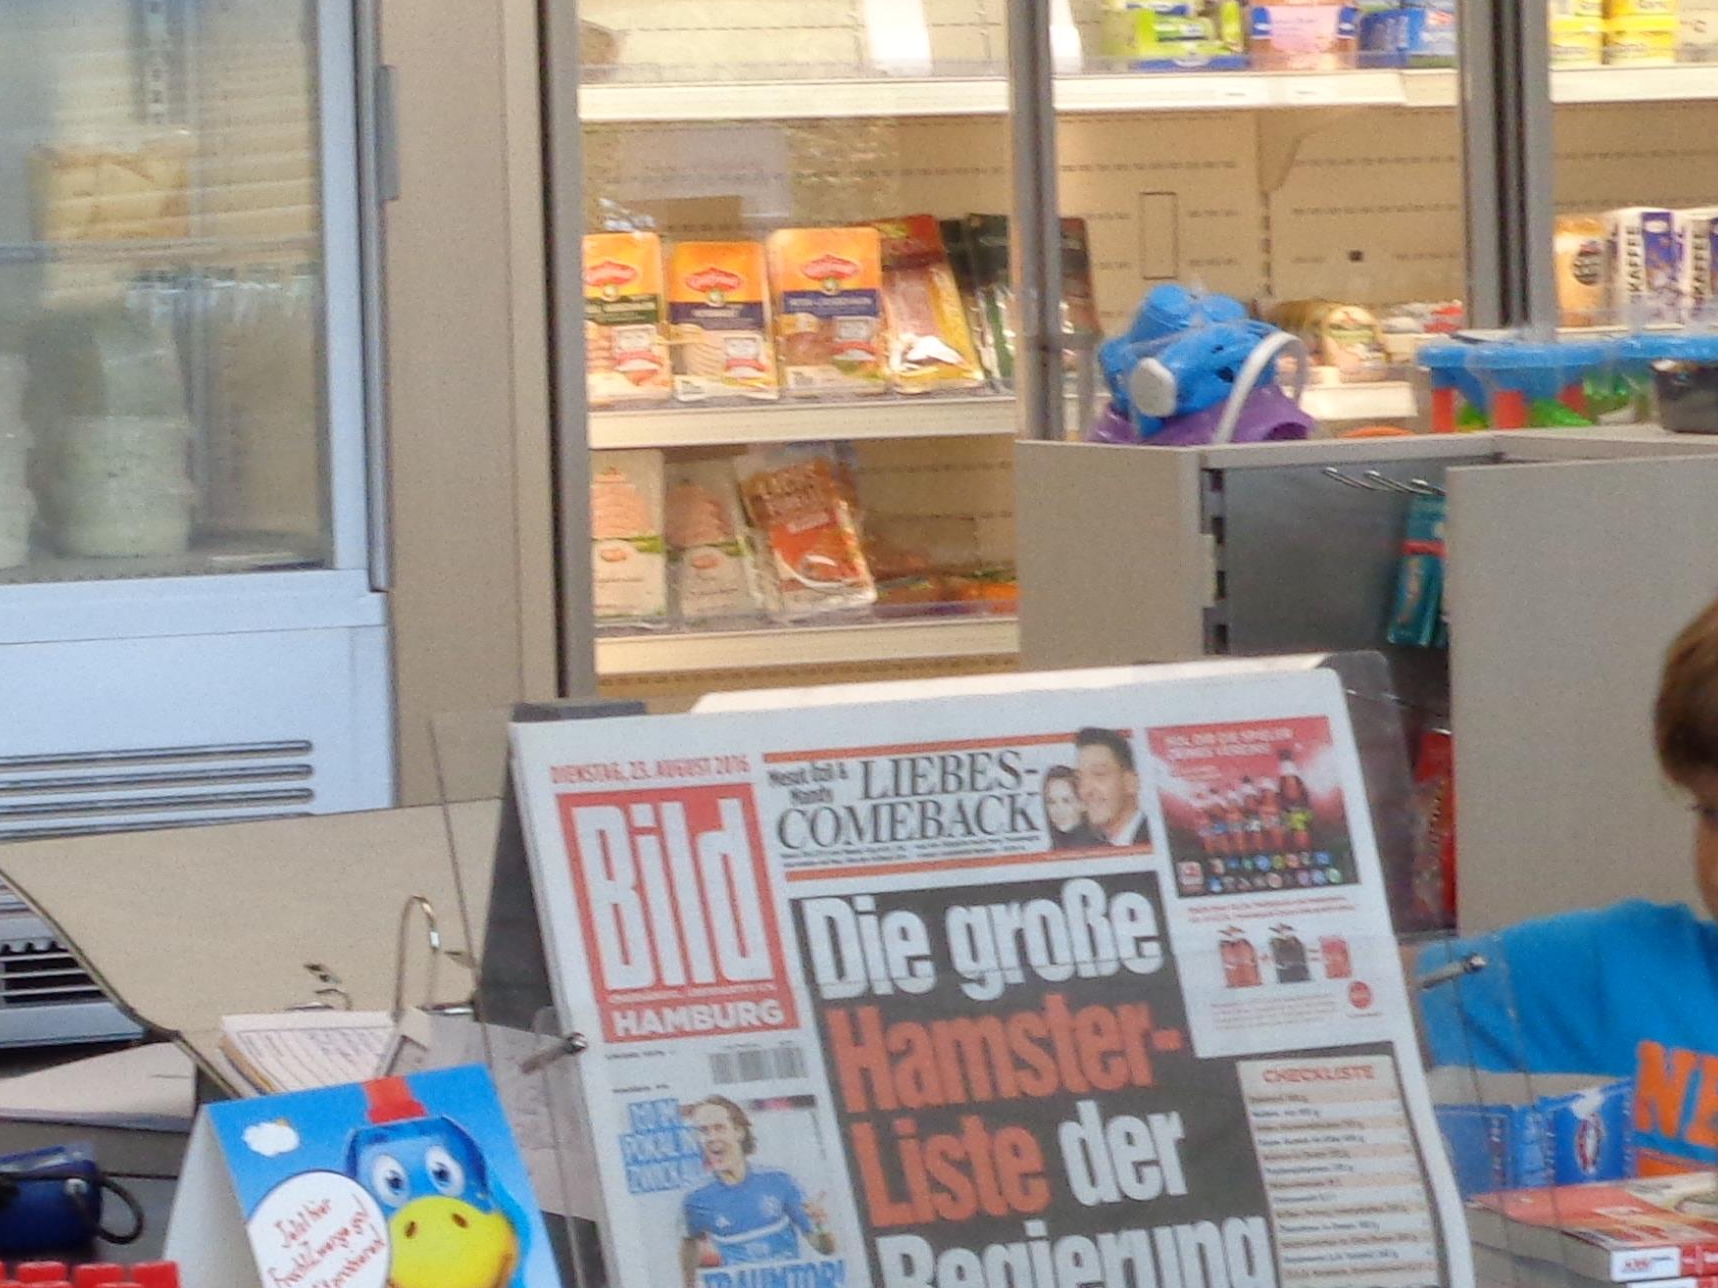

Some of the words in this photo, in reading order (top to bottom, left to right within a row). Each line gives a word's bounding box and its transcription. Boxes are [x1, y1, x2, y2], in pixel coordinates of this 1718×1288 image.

[656, 757, 713, 778] AUGUST
[859, 749, 1039, 802] LIEBES-
[778, 792, 1041, 850] COMEBACK
[571, 797, 775, 992] Bild
[803, 895, 936, 1000] Die
[946, 878, 1164, 1002] große
[611, 999, 784, 1037] HAMBURG
[824, 993, 1183, 1113] Hamster-
[1261, 1065, 1375, 1084] CHECKLISTE
[849, 1115, 1053, 1228] Liste
[1057, 1100, 1189, 1208] der
